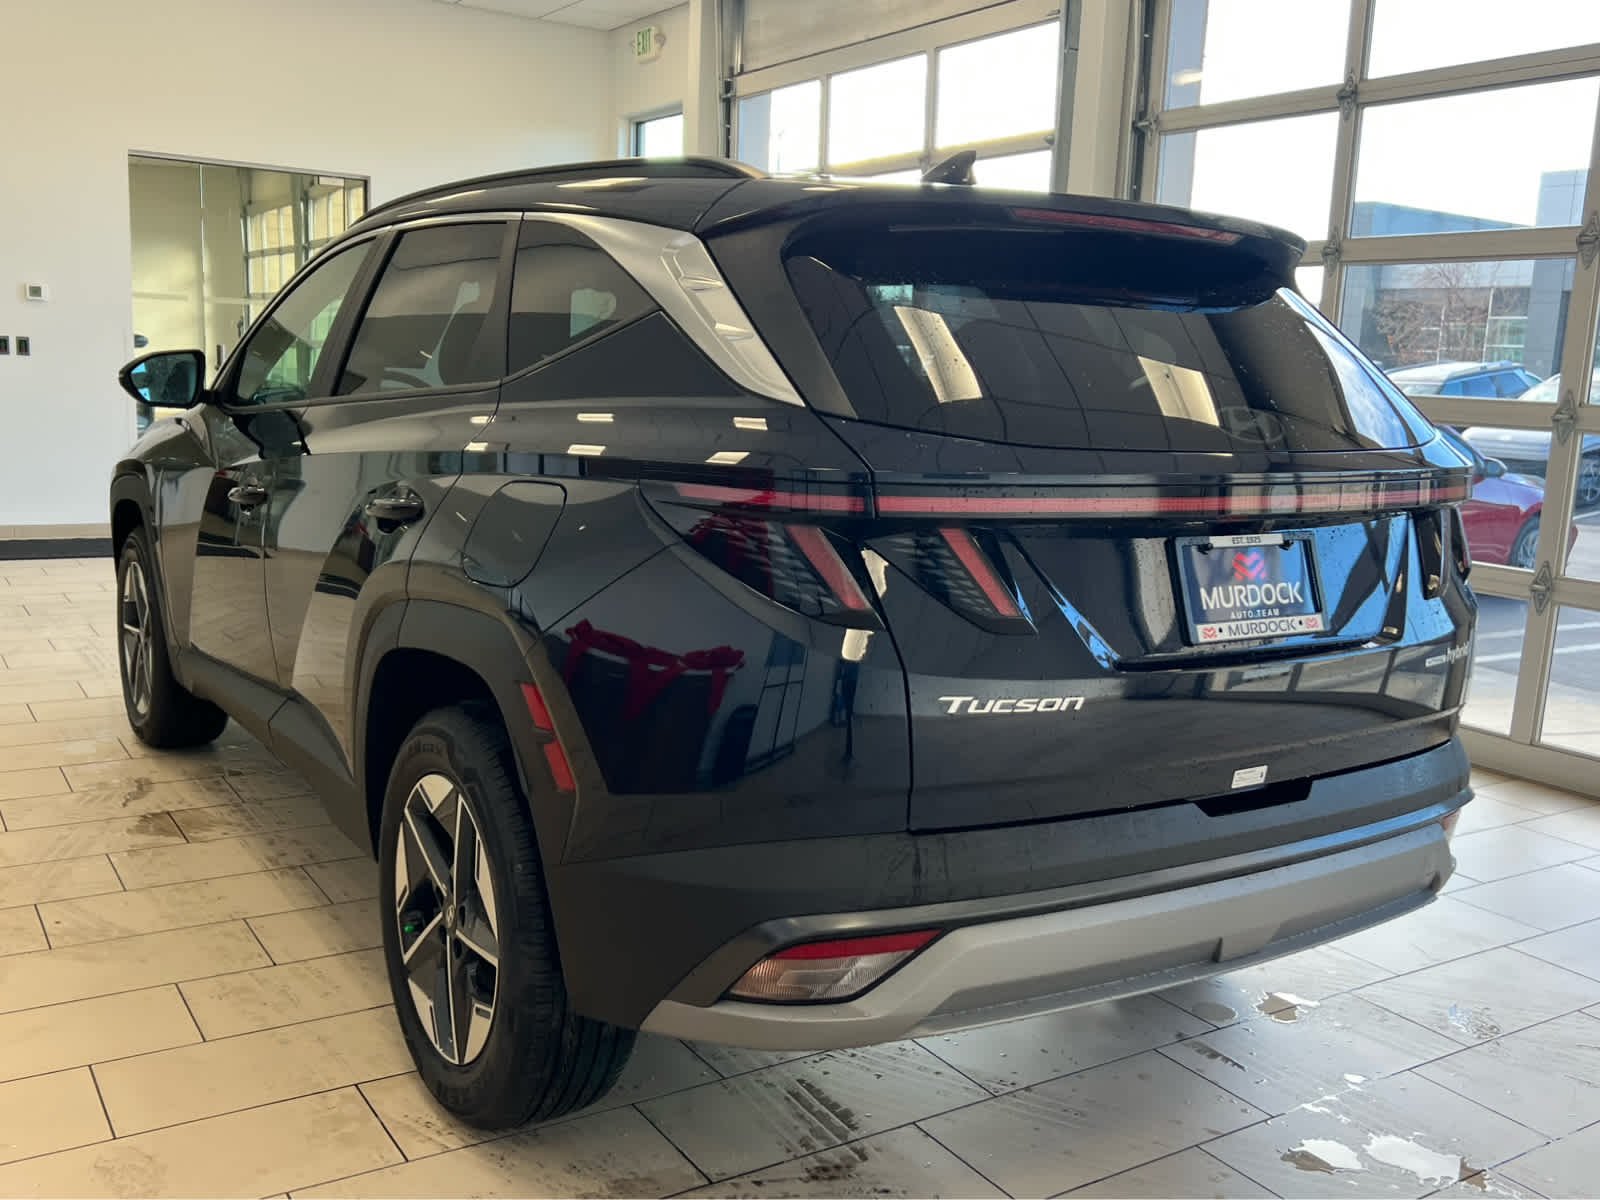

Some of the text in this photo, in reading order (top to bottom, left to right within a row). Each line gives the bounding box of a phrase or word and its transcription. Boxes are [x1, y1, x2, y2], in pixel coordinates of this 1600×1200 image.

[636, 28, 652, 57] EXIT
[1200, 581, 1304, 610] MURDOCK
[1231, 608, 1280, 619] AUTO TEAM
[1228, 618, 1297, 637] MURDOCK
